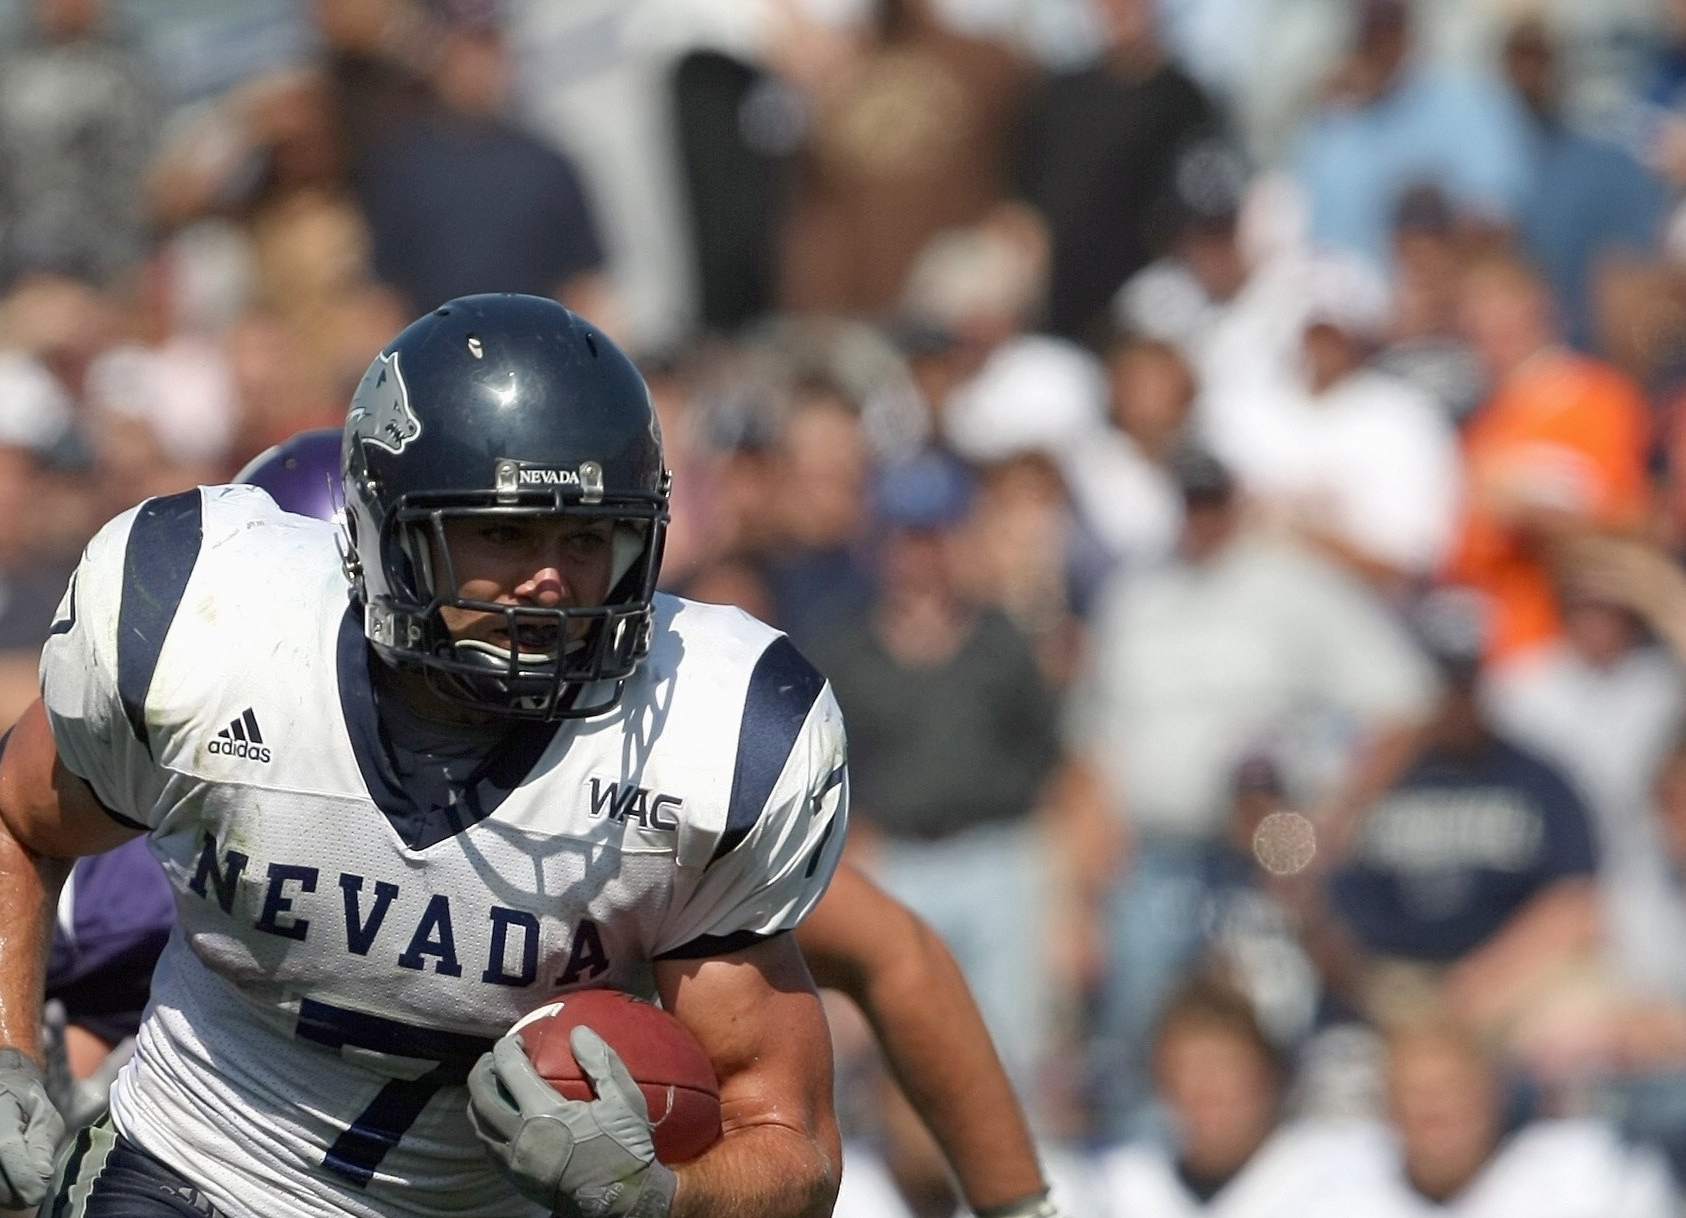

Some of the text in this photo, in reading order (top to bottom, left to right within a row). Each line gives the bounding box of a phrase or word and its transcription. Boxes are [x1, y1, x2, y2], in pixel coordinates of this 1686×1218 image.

[519, 470, 580, 484] NEVADA
[207, 736, 271, 763] adidas
[589, 777, 683, 831] WAC
[189, 832, 611, 988] NEVADA
[295, 997, 500, 1188] 7
